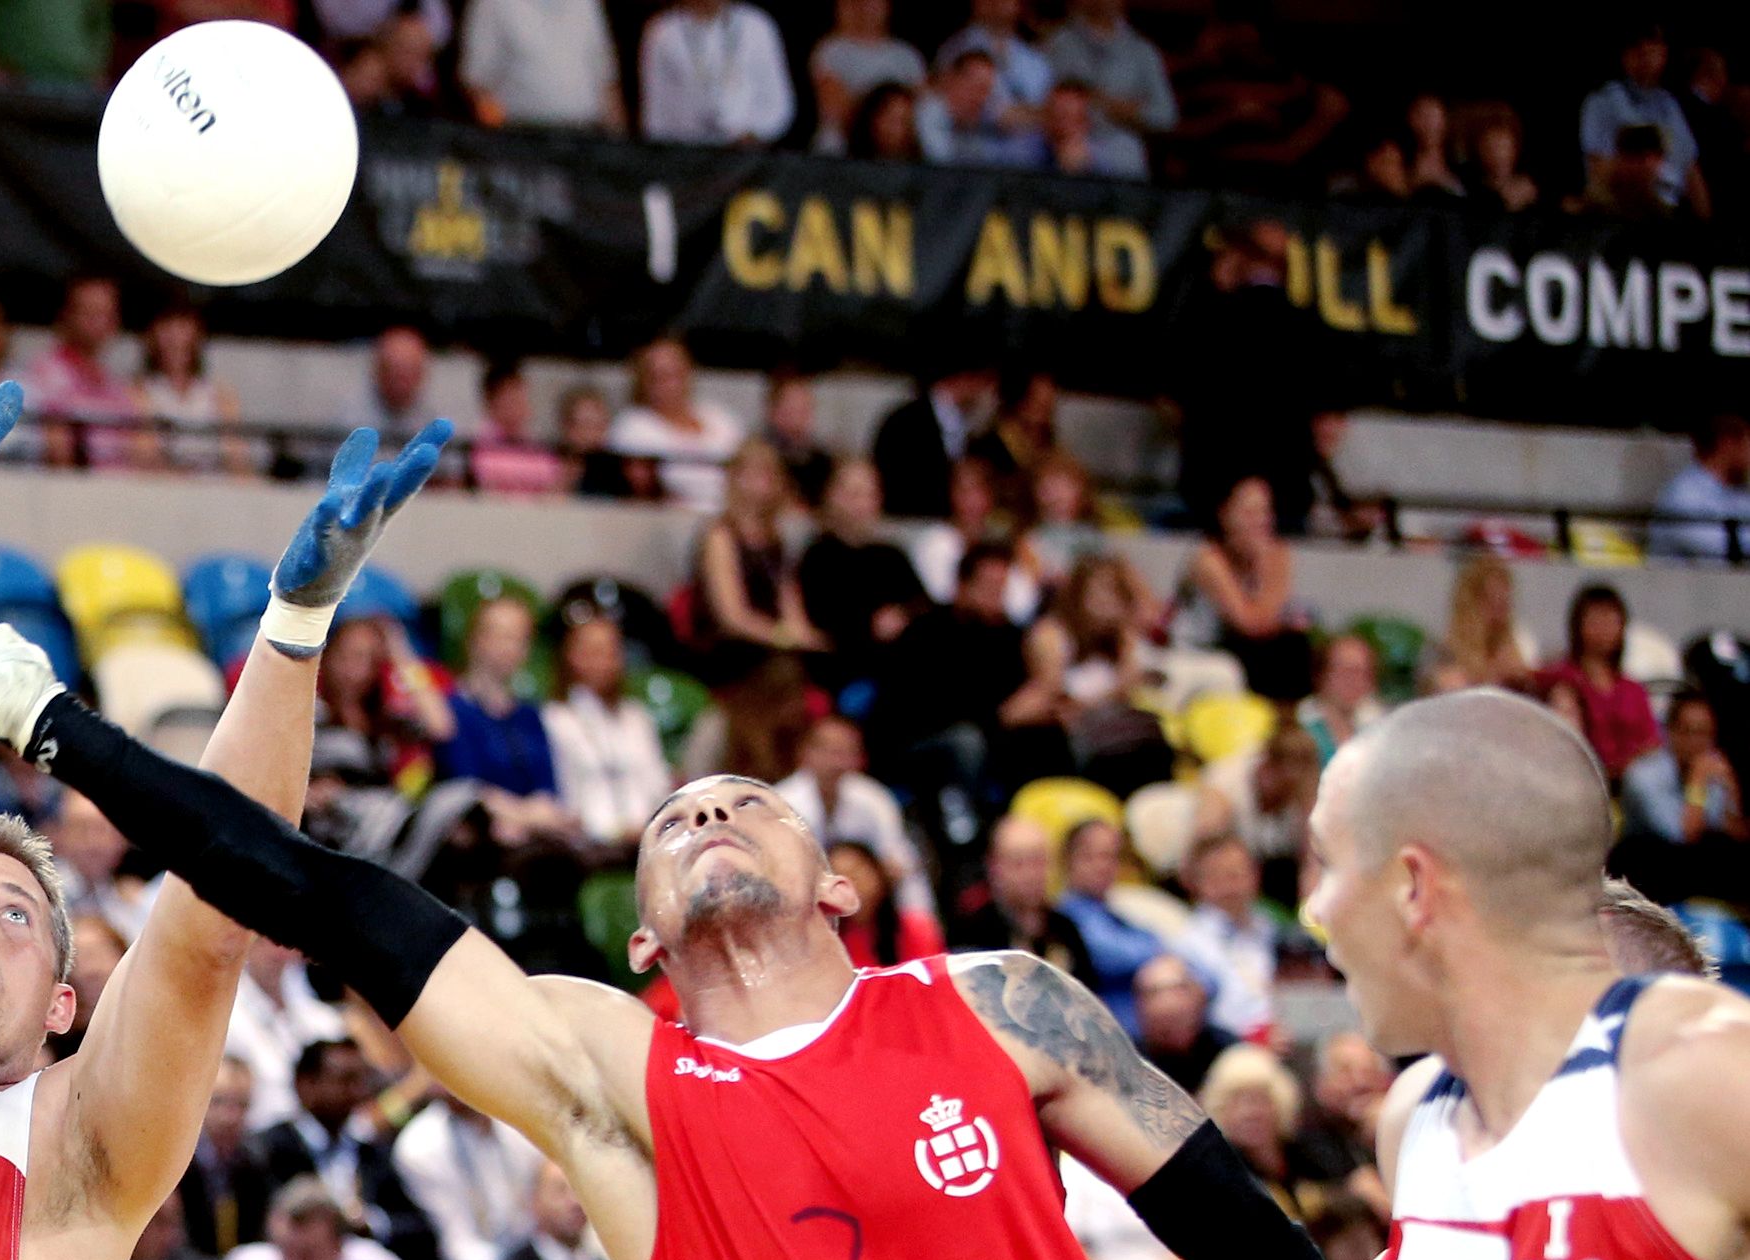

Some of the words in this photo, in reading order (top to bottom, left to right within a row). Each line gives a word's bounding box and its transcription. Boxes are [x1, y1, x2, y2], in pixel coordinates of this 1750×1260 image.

[643, 184, 677, 284] I
[722, 190, 916, 298] CAN
[964, 211, 1158, 314] AND
[1204, 222, 1418, 335] ILL
[1467, 246, 1750, 358] COMPE
[1544, 1201, 1571, 1259] I
